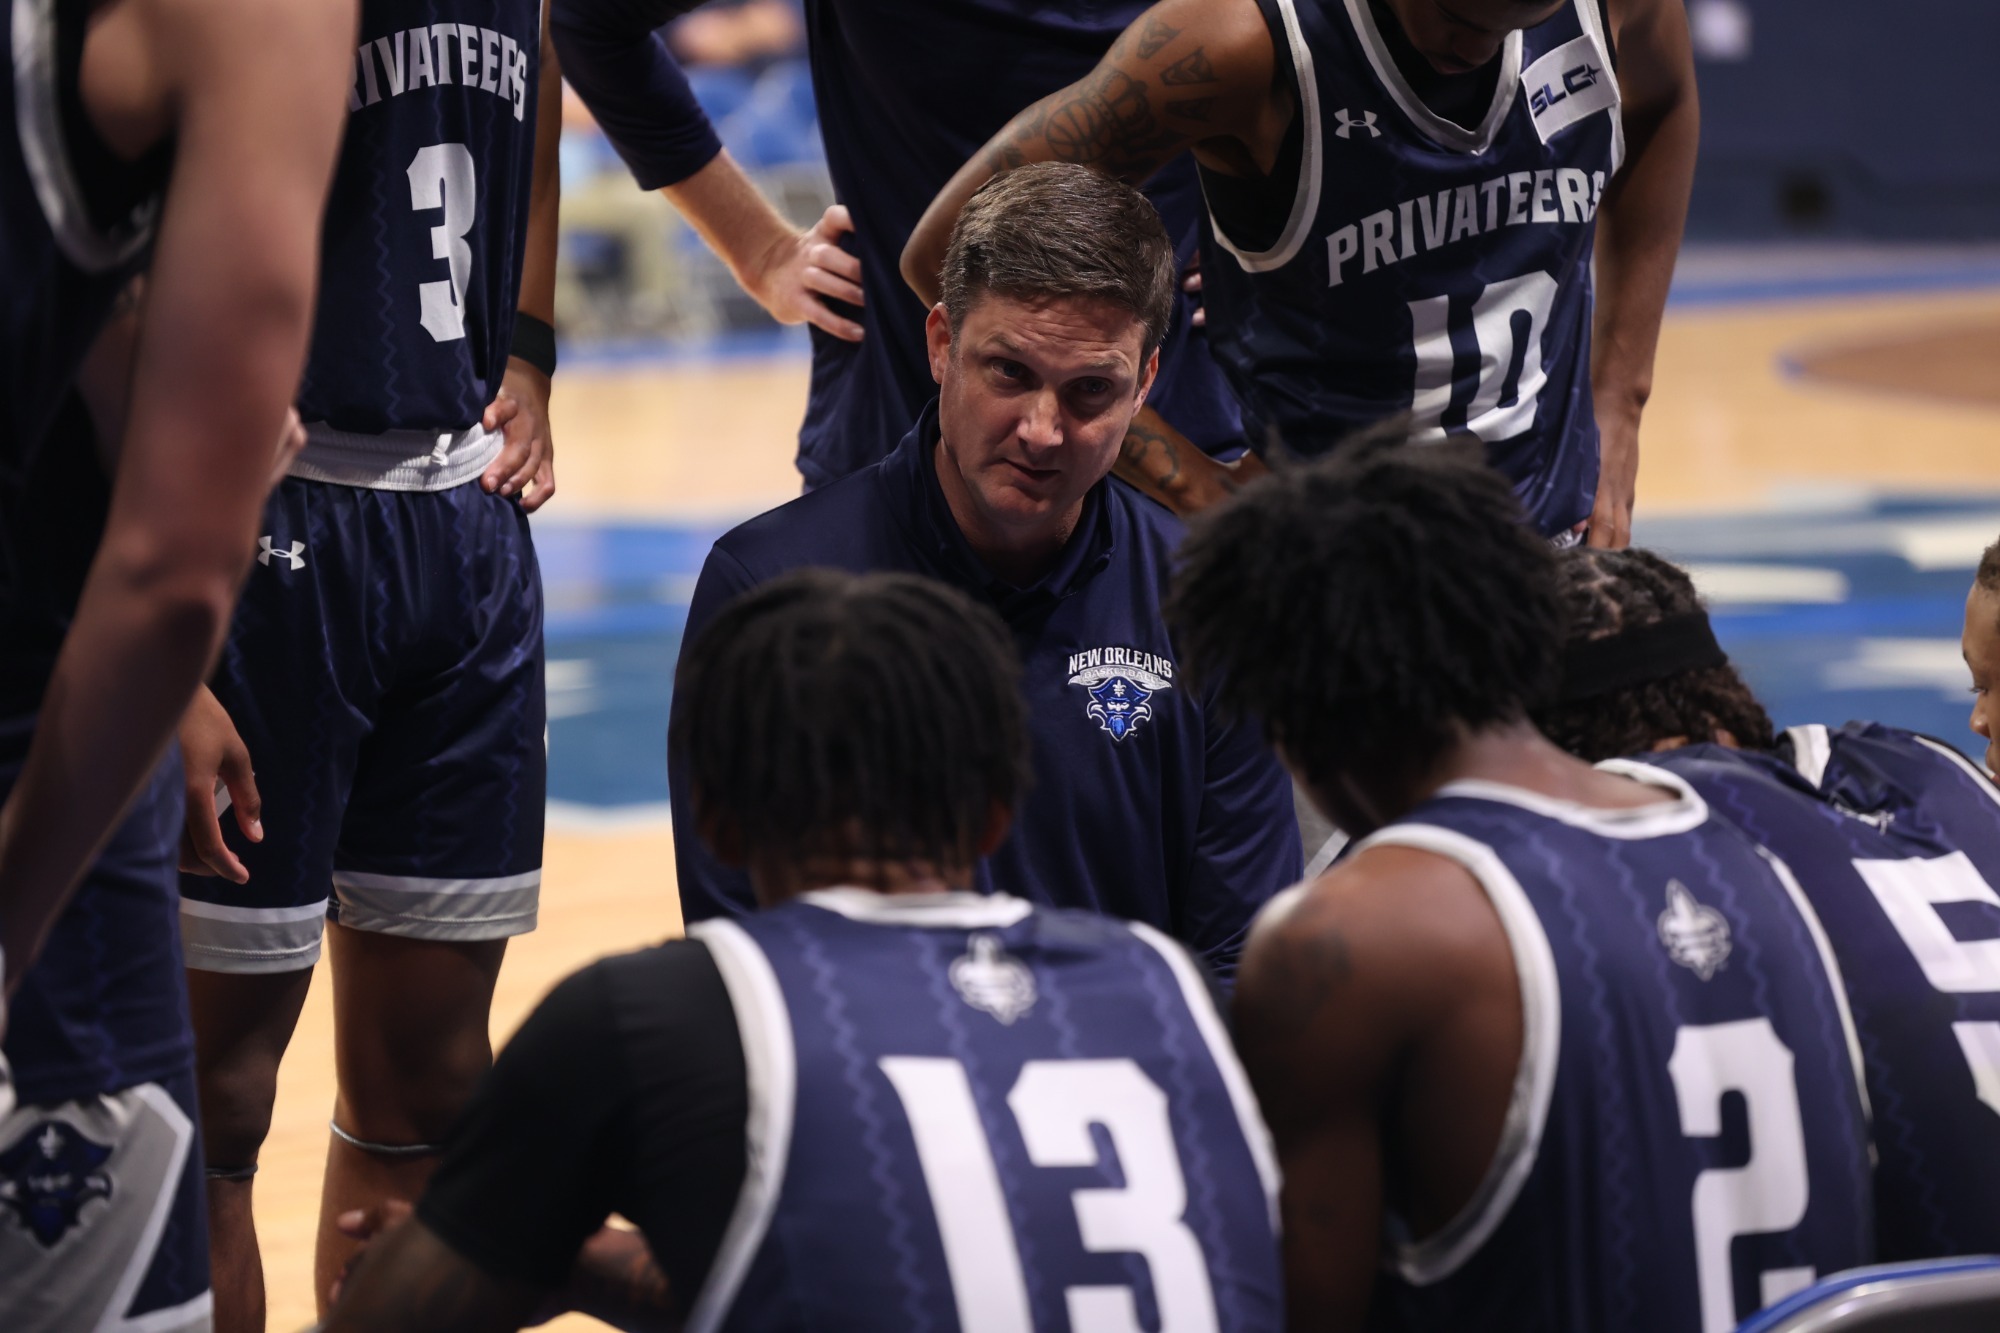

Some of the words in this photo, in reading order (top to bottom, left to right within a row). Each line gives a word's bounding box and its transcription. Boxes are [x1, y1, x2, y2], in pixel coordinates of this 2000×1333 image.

[350, 22, 527, 122] IVATEERS
[1530, 64, 1594, 118] SLC
[406, 142, 476, 342] 3
[1325, 167, 1605, 288] PRIVATEERS
[1407, 270, 1559, 443] 10
[1068, 647, 1102, 675] NEW
[1105, 647, 1172, 678] ORLEANS
[1084, 666, 1163, 684] BASKETBALL
[877, 1055, 1220, 1333] 13
[1667, 1016, 1816, 1333] 2
